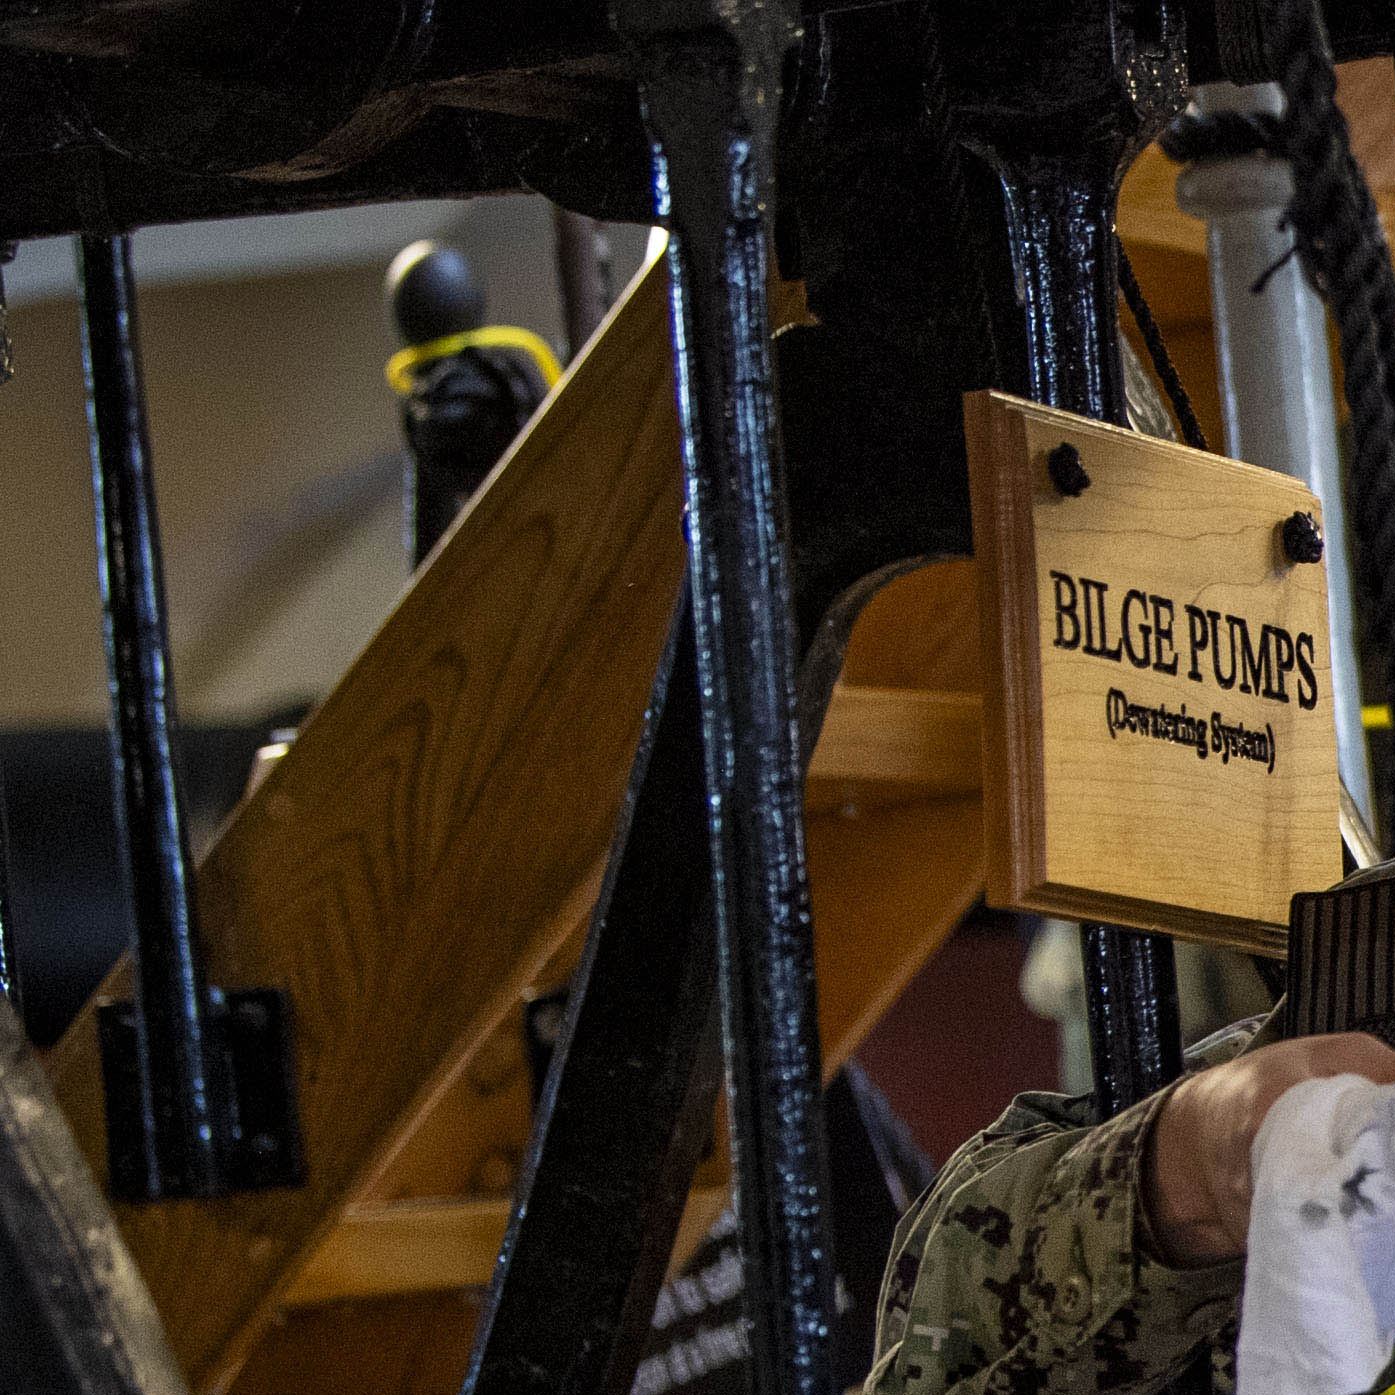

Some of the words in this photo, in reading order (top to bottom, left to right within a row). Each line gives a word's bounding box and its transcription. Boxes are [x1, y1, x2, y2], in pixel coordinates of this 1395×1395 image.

[1050, 569, 1178, 677] BILGE
[1184, 603, 1319, 711] PUMPS
[1107, 686, 1209, 760] (Dewatering
[1210, 711, 1276, 775] System)
